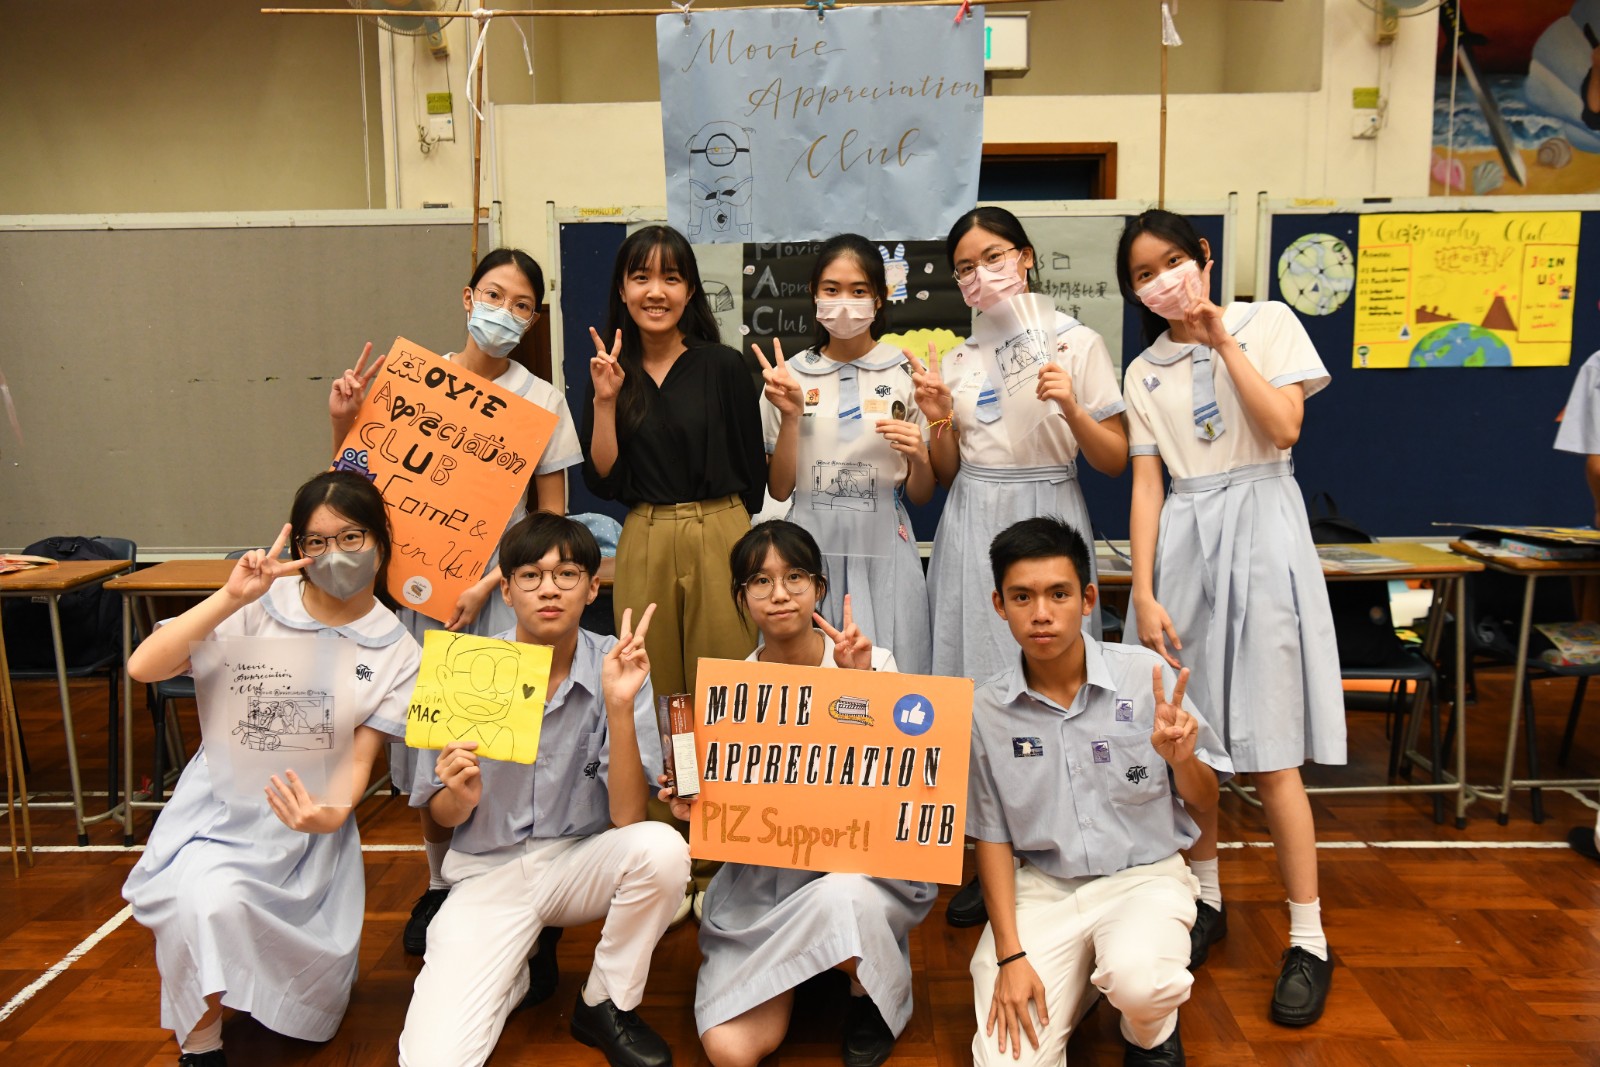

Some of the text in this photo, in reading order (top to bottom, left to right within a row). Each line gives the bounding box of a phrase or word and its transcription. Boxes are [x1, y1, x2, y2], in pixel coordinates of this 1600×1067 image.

[682, 28, 847, 72] Movie
[744, 75, 984, 120] Appreciation
[786, 128, 928, 182] Club
[1531, 256, 1565, 268] JOIN
[752, 305, 807, 335] Club
[360, 421, 458, 486] CLUB
[379, 474, 488, 540] Come &
[232, 662, 266, 673] Movie
[407, 704, 441, 723] MAC
[415, 685, 442, 704] Join
[705, 682, 813, 726] MOVIE
[704, 742, 941, 788] APPRECIATION
[757, 806, 871, 866] Support!
[895, 801, 956, 846] LUB
